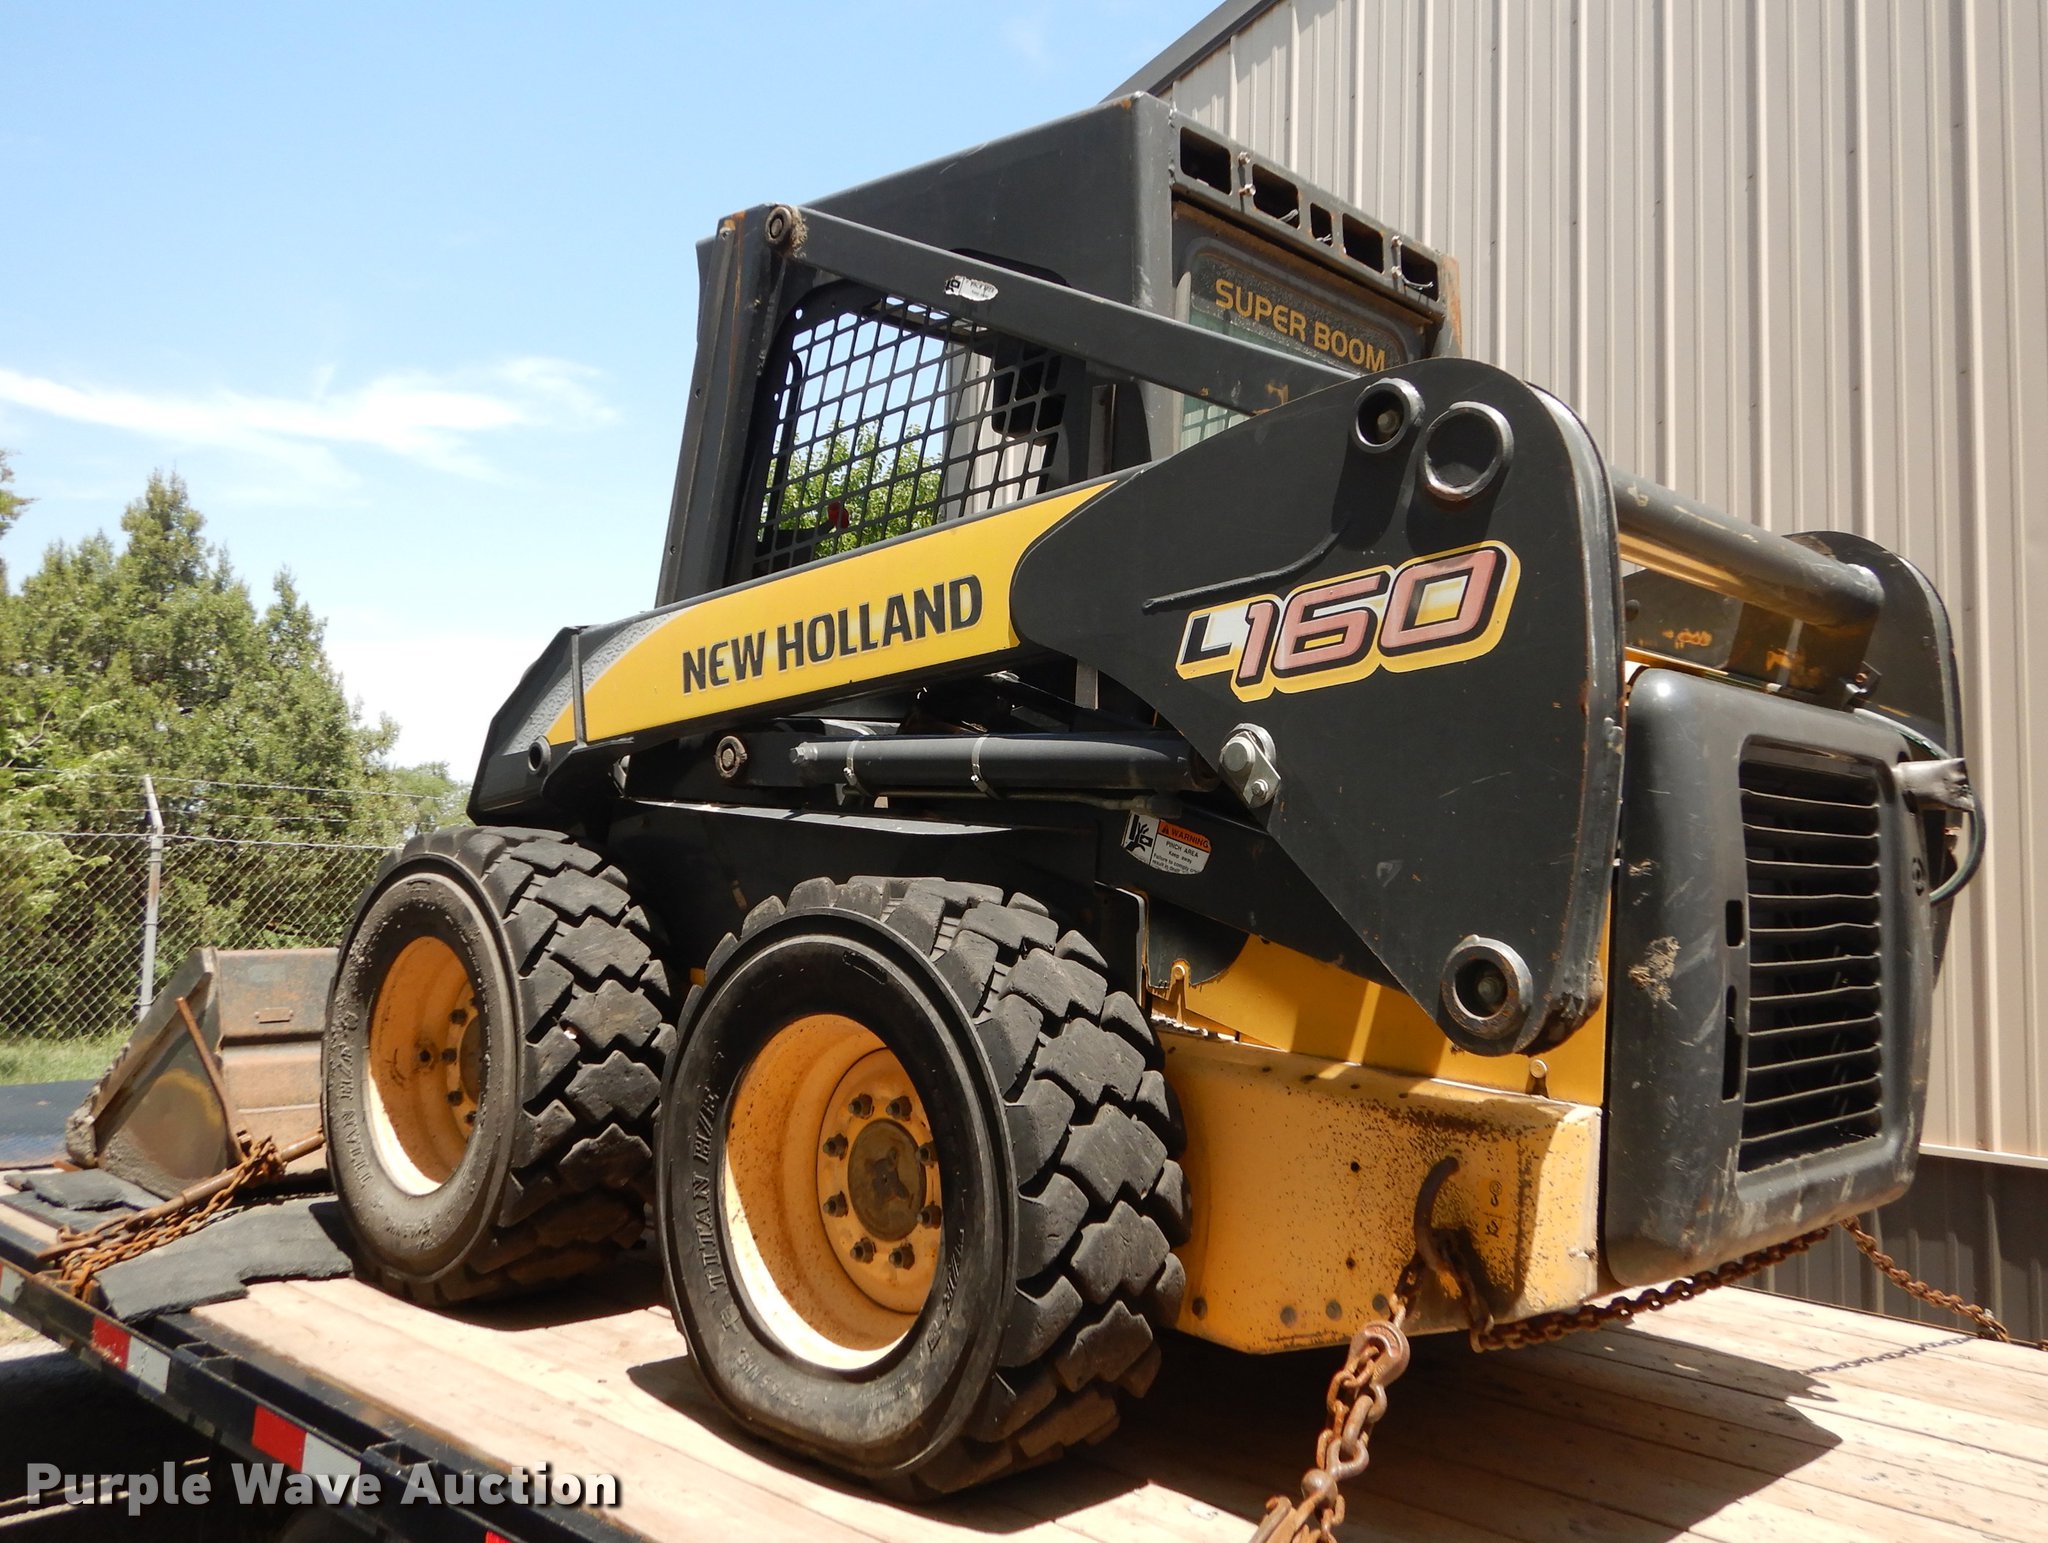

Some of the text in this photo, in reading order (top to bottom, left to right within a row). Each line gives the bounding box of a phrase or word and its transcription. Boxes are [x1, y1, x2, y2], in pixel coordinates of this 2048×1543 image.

[1215, 278, 1386, 373] SUPER BOOM
[682, 574, 984, 695] NEW HOLLAND
[1166, 841, 1199, 858] PINCH AREA
[1171, 828, 1209, 848] WARNING
[692, 1172, 728, 1294] TITAN
